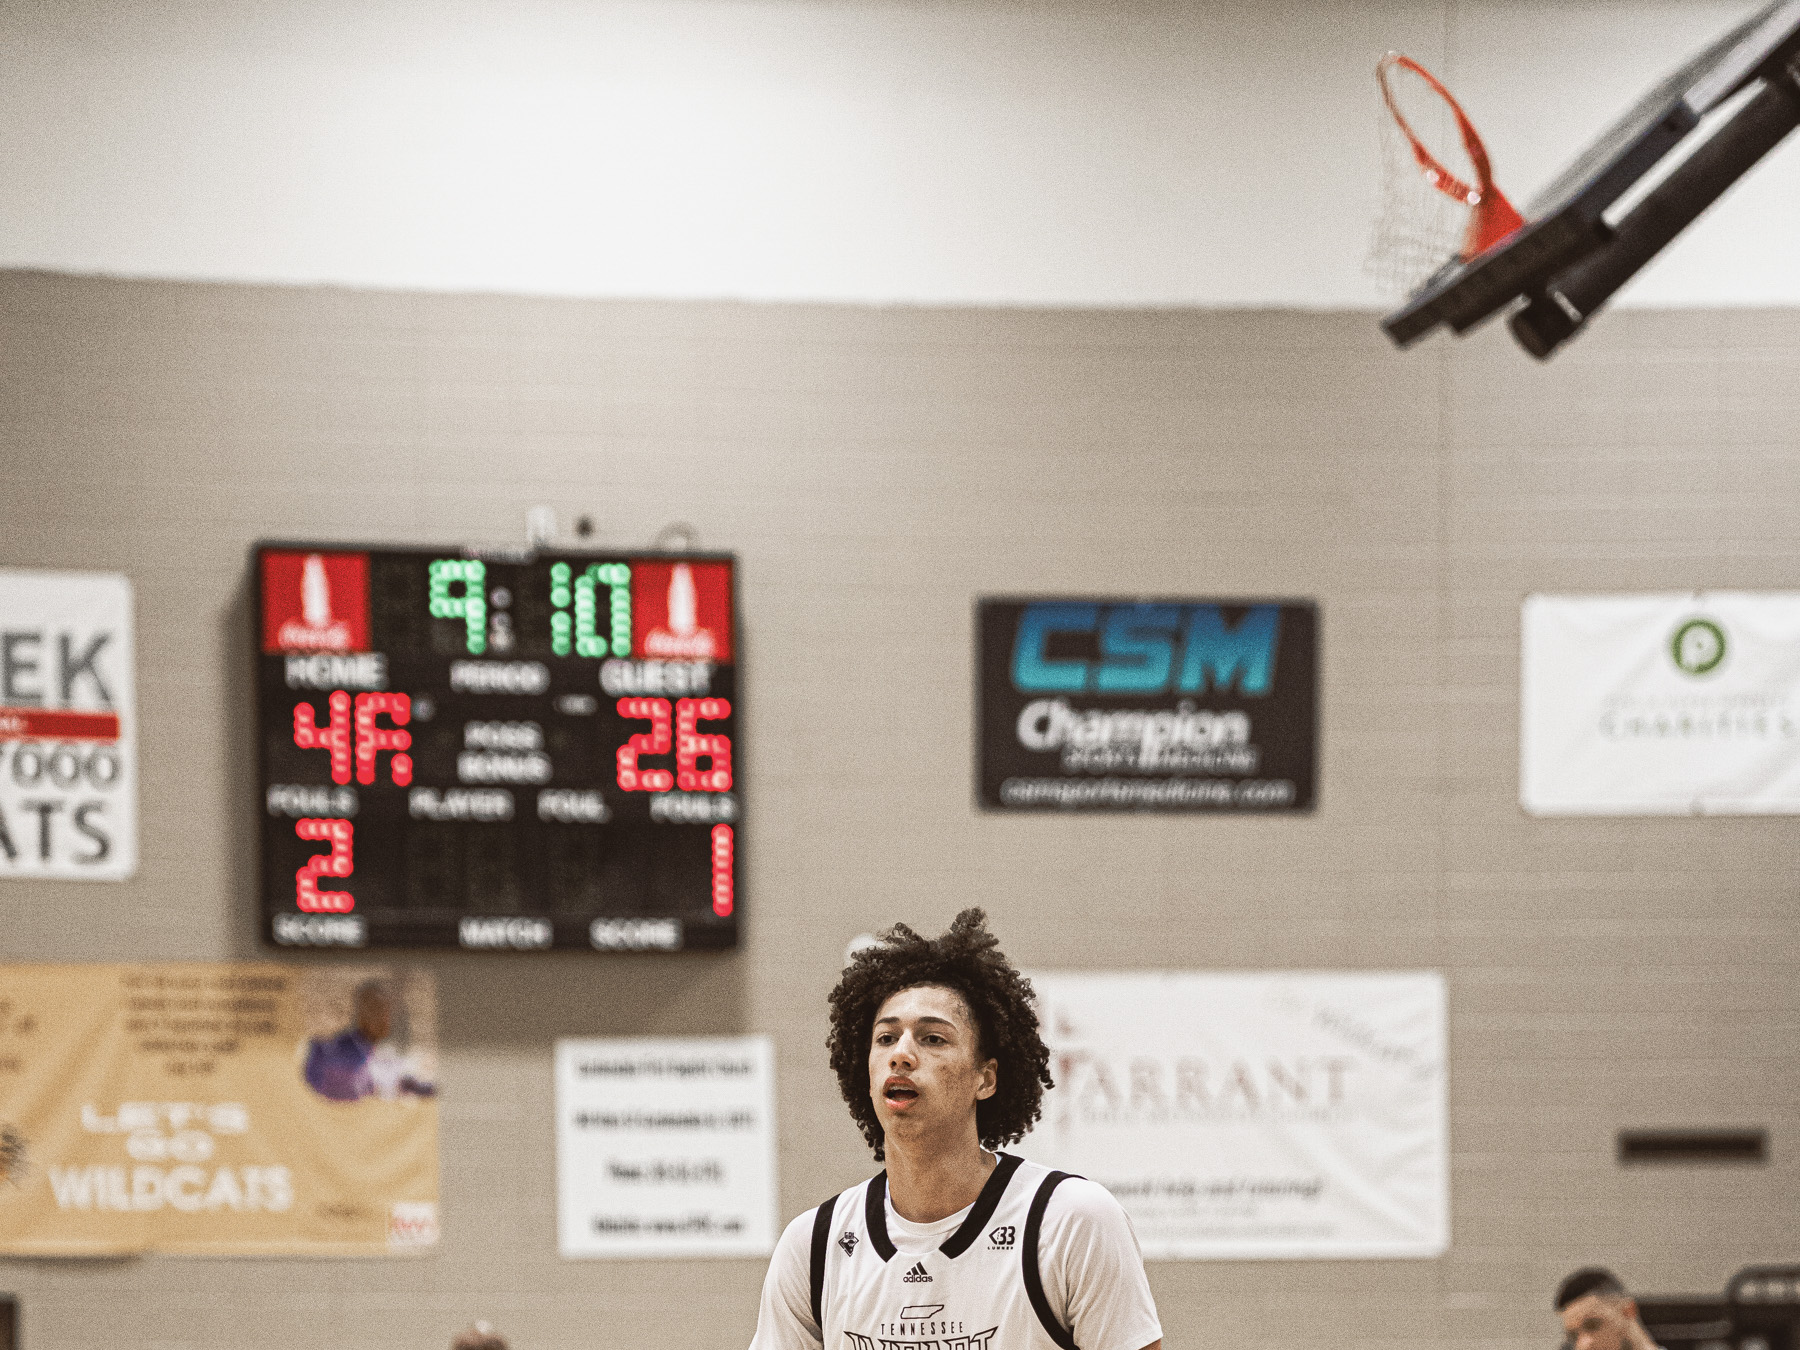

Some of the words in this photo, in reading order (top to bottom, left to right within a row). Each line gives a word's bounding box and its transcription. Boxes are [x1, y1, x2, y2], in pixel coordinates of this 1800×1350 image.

[1013, 602, 1282, 693] CSM
[284, 652, 389, 690] HOME
[599, 658, 717, 697] GUEST
[616, 697, 733, 793] 26
[1016, 697, 1251, 769] Champion
[0, 741, 120, 792] 000
[456, 750, 554, 784] BONUS
[266, 784, 359, 818] FOULS
[408, 788, 515, 821] PLAYER
[650, 791, 738, 824] FOULS
[295, 818, 354, 913] 2
[711, 823, 734, 917] 1
[272, 912, 367, 947] SCORE
[458, 916, 554, 951] MATCH
[589, 917, 684, 952] SCORE
[126, 1130, 214, 1162] GO
[48, 1165, 294, 1212] WILDCATS
[903, 1274, 933, 1283] adidas
[881, 1321, 963, 1336] TENNESSEE
